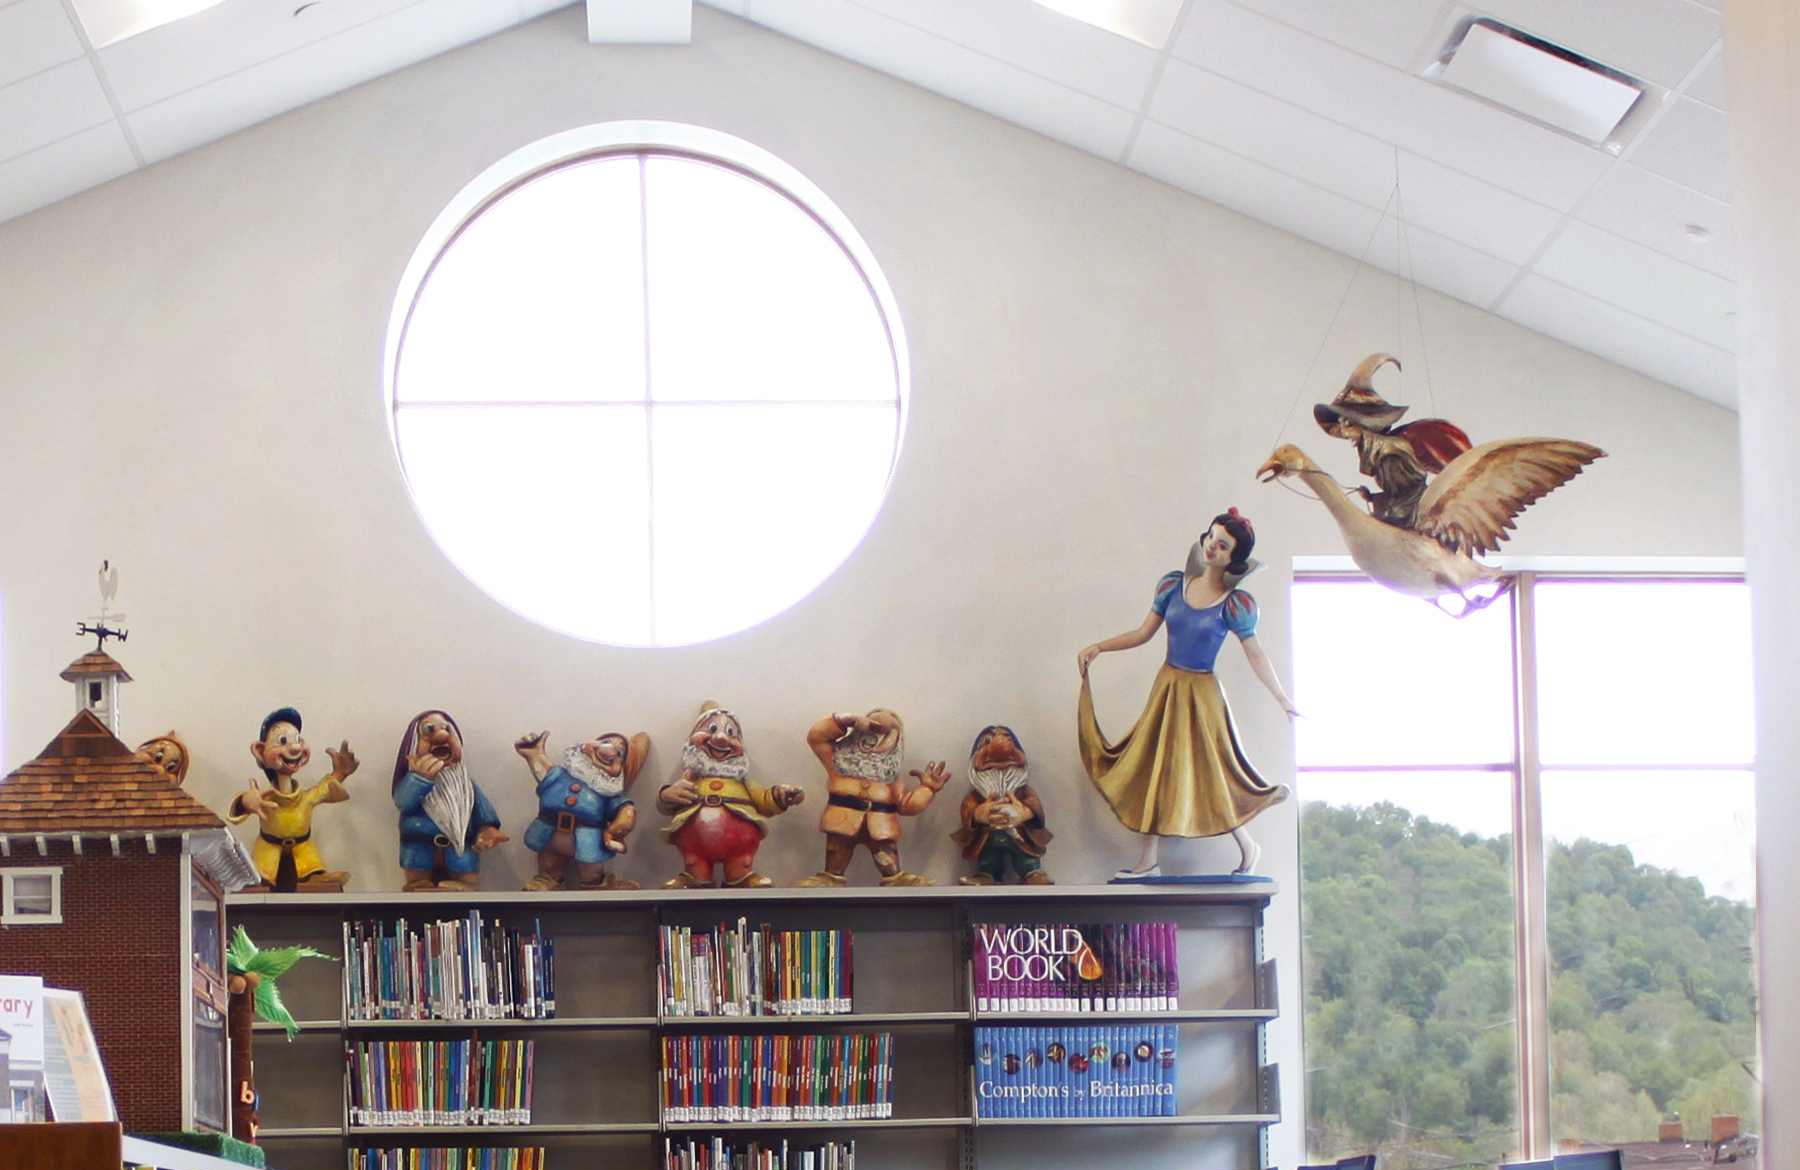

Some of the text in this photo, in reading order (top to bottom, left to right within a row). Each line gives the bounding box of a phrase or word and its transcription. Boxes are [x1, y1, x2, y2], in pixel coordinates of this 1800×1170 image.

[980, 928, 1083, 955] WORLD
[988, 955, 1065, 981] BOOK
[0, 998, 33, 1020] ary
[240, 1080, 255, 1104] b
[979, 1080, 1069, 1103] Compton's
[1090, 1079, 1173, 1098] Britannica
